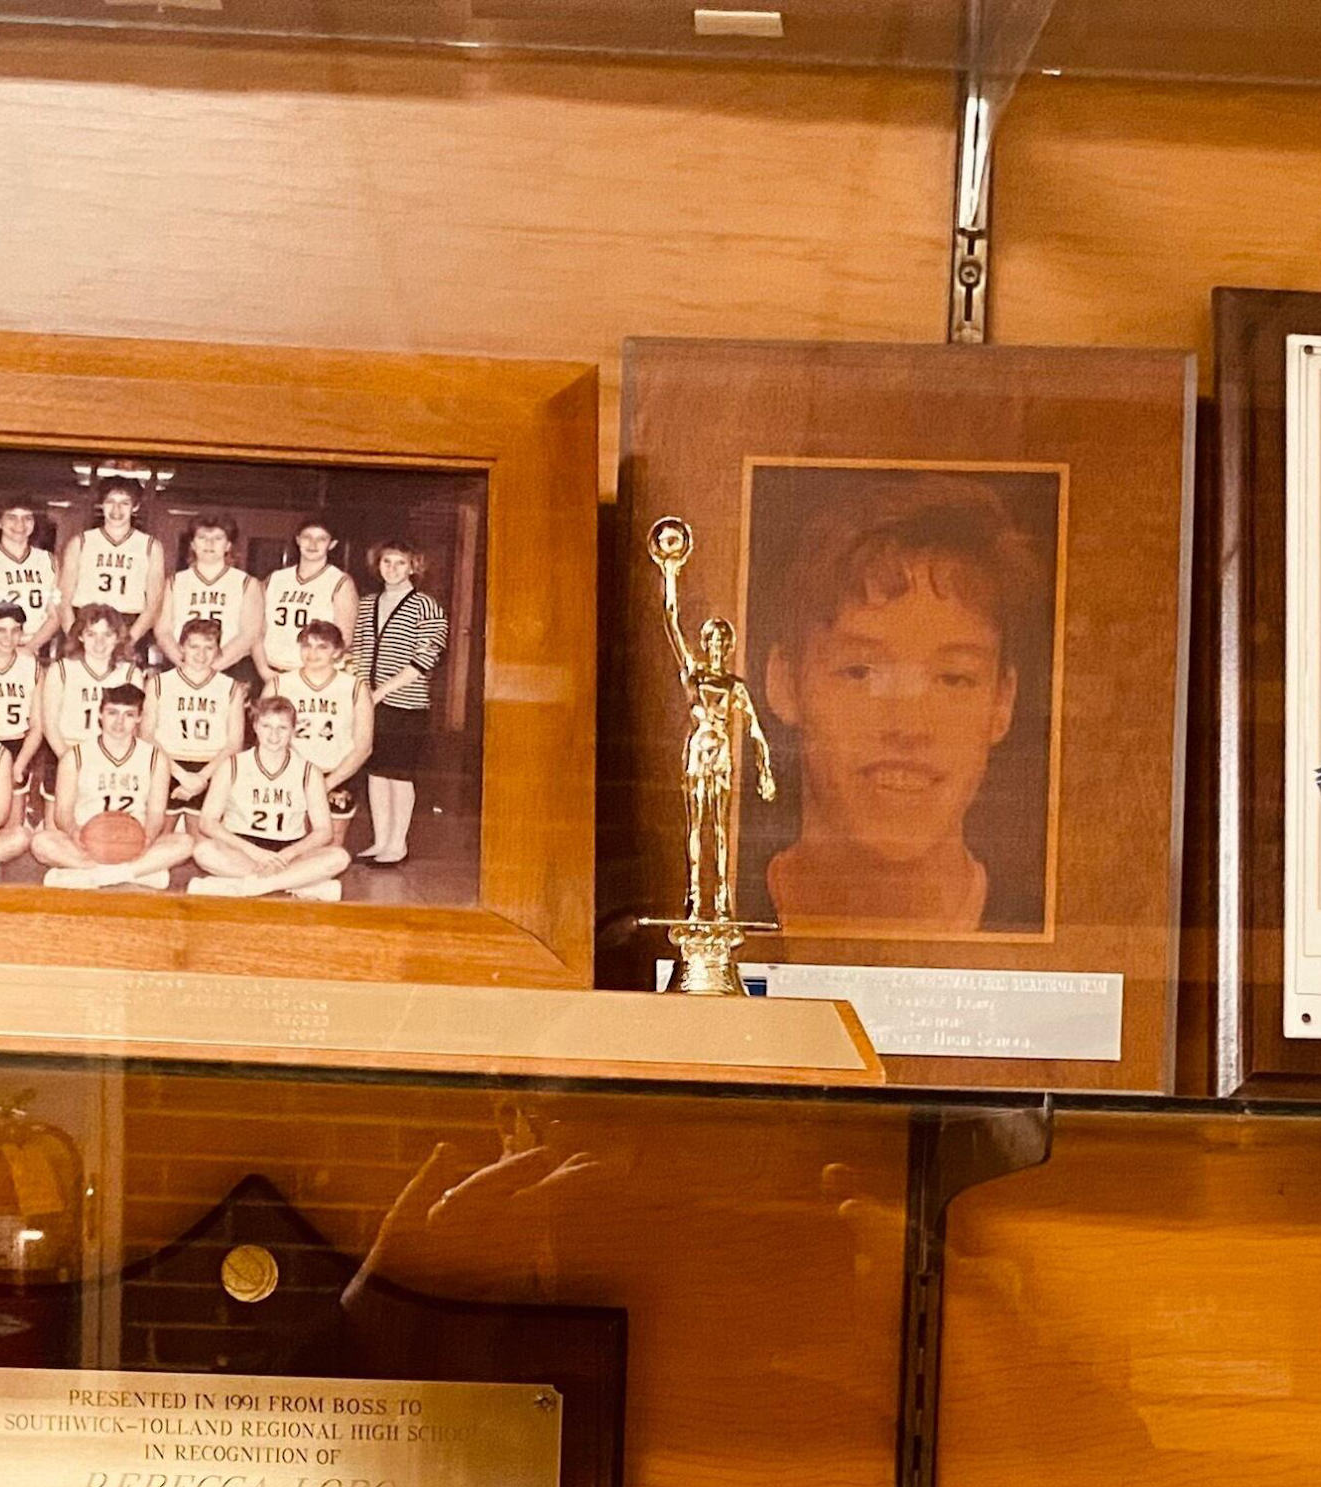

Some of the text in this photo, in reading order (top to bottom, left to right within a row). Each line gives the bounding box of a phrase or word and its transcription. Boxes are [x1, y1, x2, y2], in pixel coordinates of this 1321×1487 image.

[96, 553, 133, 569] RAMS
[5, 570, 43, 585] RAMS
[98, 573, 128, 595] 31
[190, 591, 226, 607] RAMS
[279, 590, 315, 606] RAMS
[274, 607, 308, 628] 30
[178, 697, 216, 714] RAMS
[298, 699, 337, 715] RAMS
[180, 718, 210, 740] 10
[252, 788, 292, 807] RAMS
[251, 810, 285, 832] 21
[69, 1389, 186, 1409] PRESENTED
[195, 1394, 215, 1410] IN
[224, 1394, 260, 1411] 1991
[269, 1395, 323, 1413] FROM
[398, 1399, 422, 1416] TO
[241, 1421, 343, 1440] REGIONAL
[351, 1424, 399, 1441] HIGH
[407, 1425, 472, 1443] SCHOO
[145, 1444, 342, 1465] IN RECOGNITION OF
